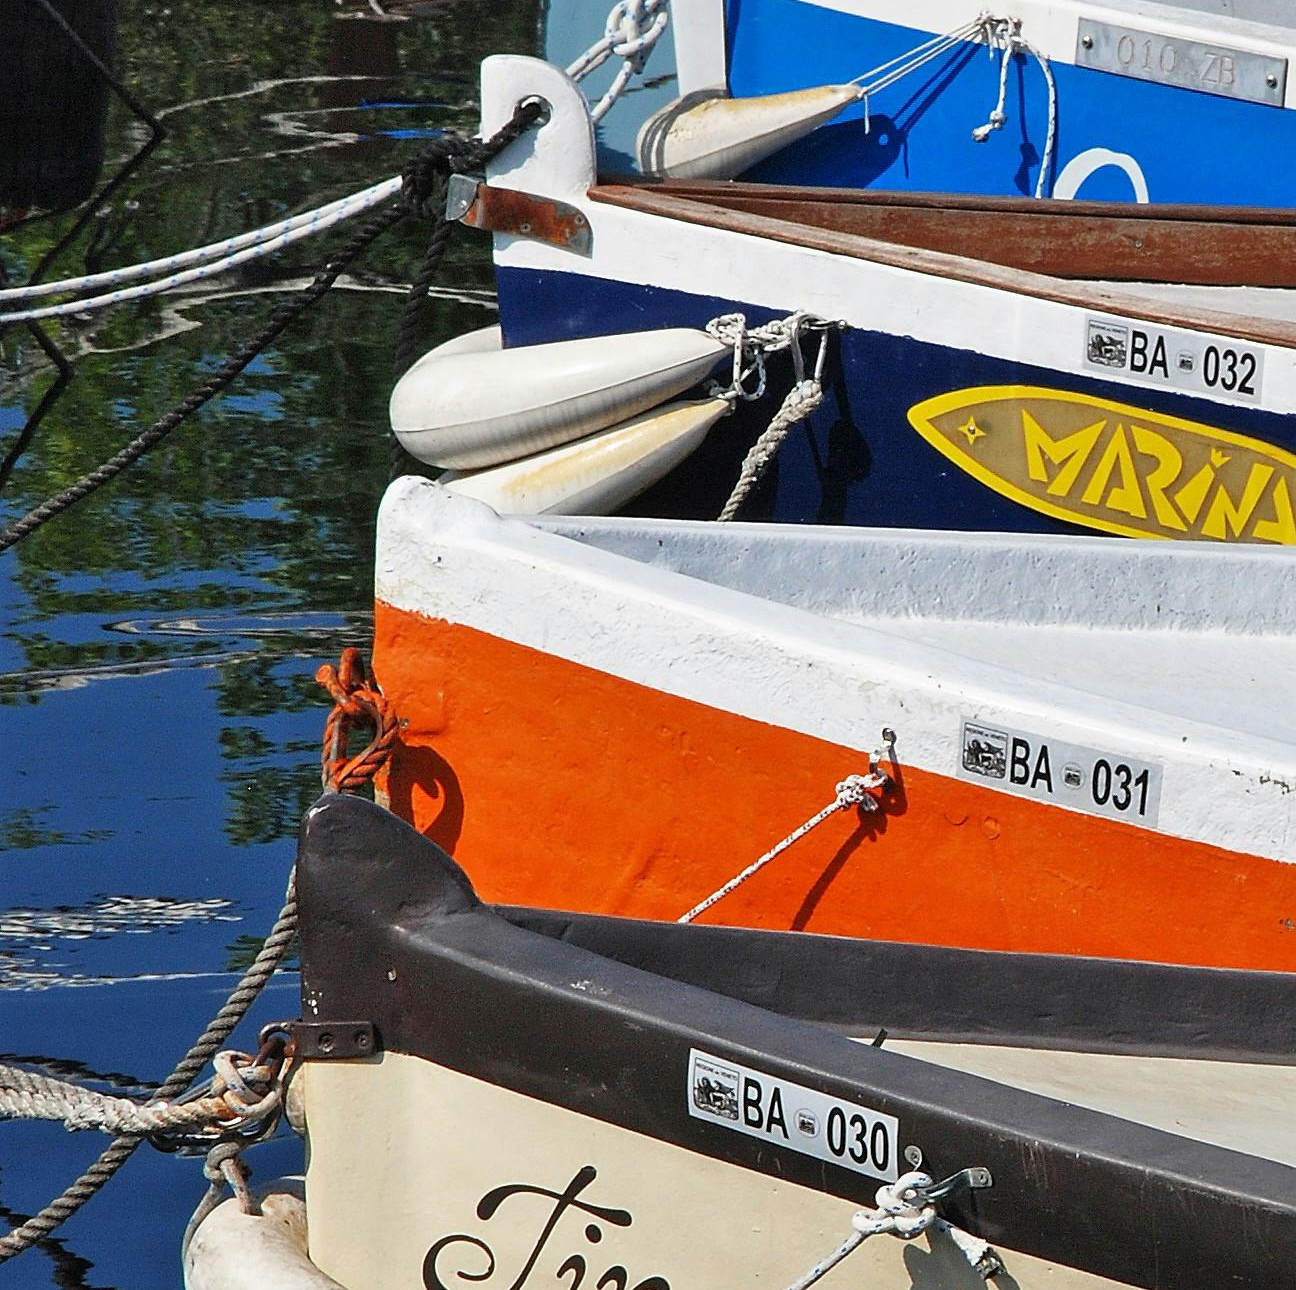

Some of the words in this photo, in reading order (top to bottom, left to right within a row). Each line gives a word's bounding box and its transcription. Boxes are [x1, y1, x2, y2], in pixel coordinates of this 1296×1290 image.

[1117, 35, 1177, 75] 010
[1199, 52, 1236, 85] ZB
[1130, 330, 1169, 378] BA
[1203, 345, 1257, 395] 032
[1010, 737, 1053, 793] BA
[1092, 759, 1149, 816] 031
[743, 1077, 790, 1140] BA
[827, 1106, 889, 1172] 030
